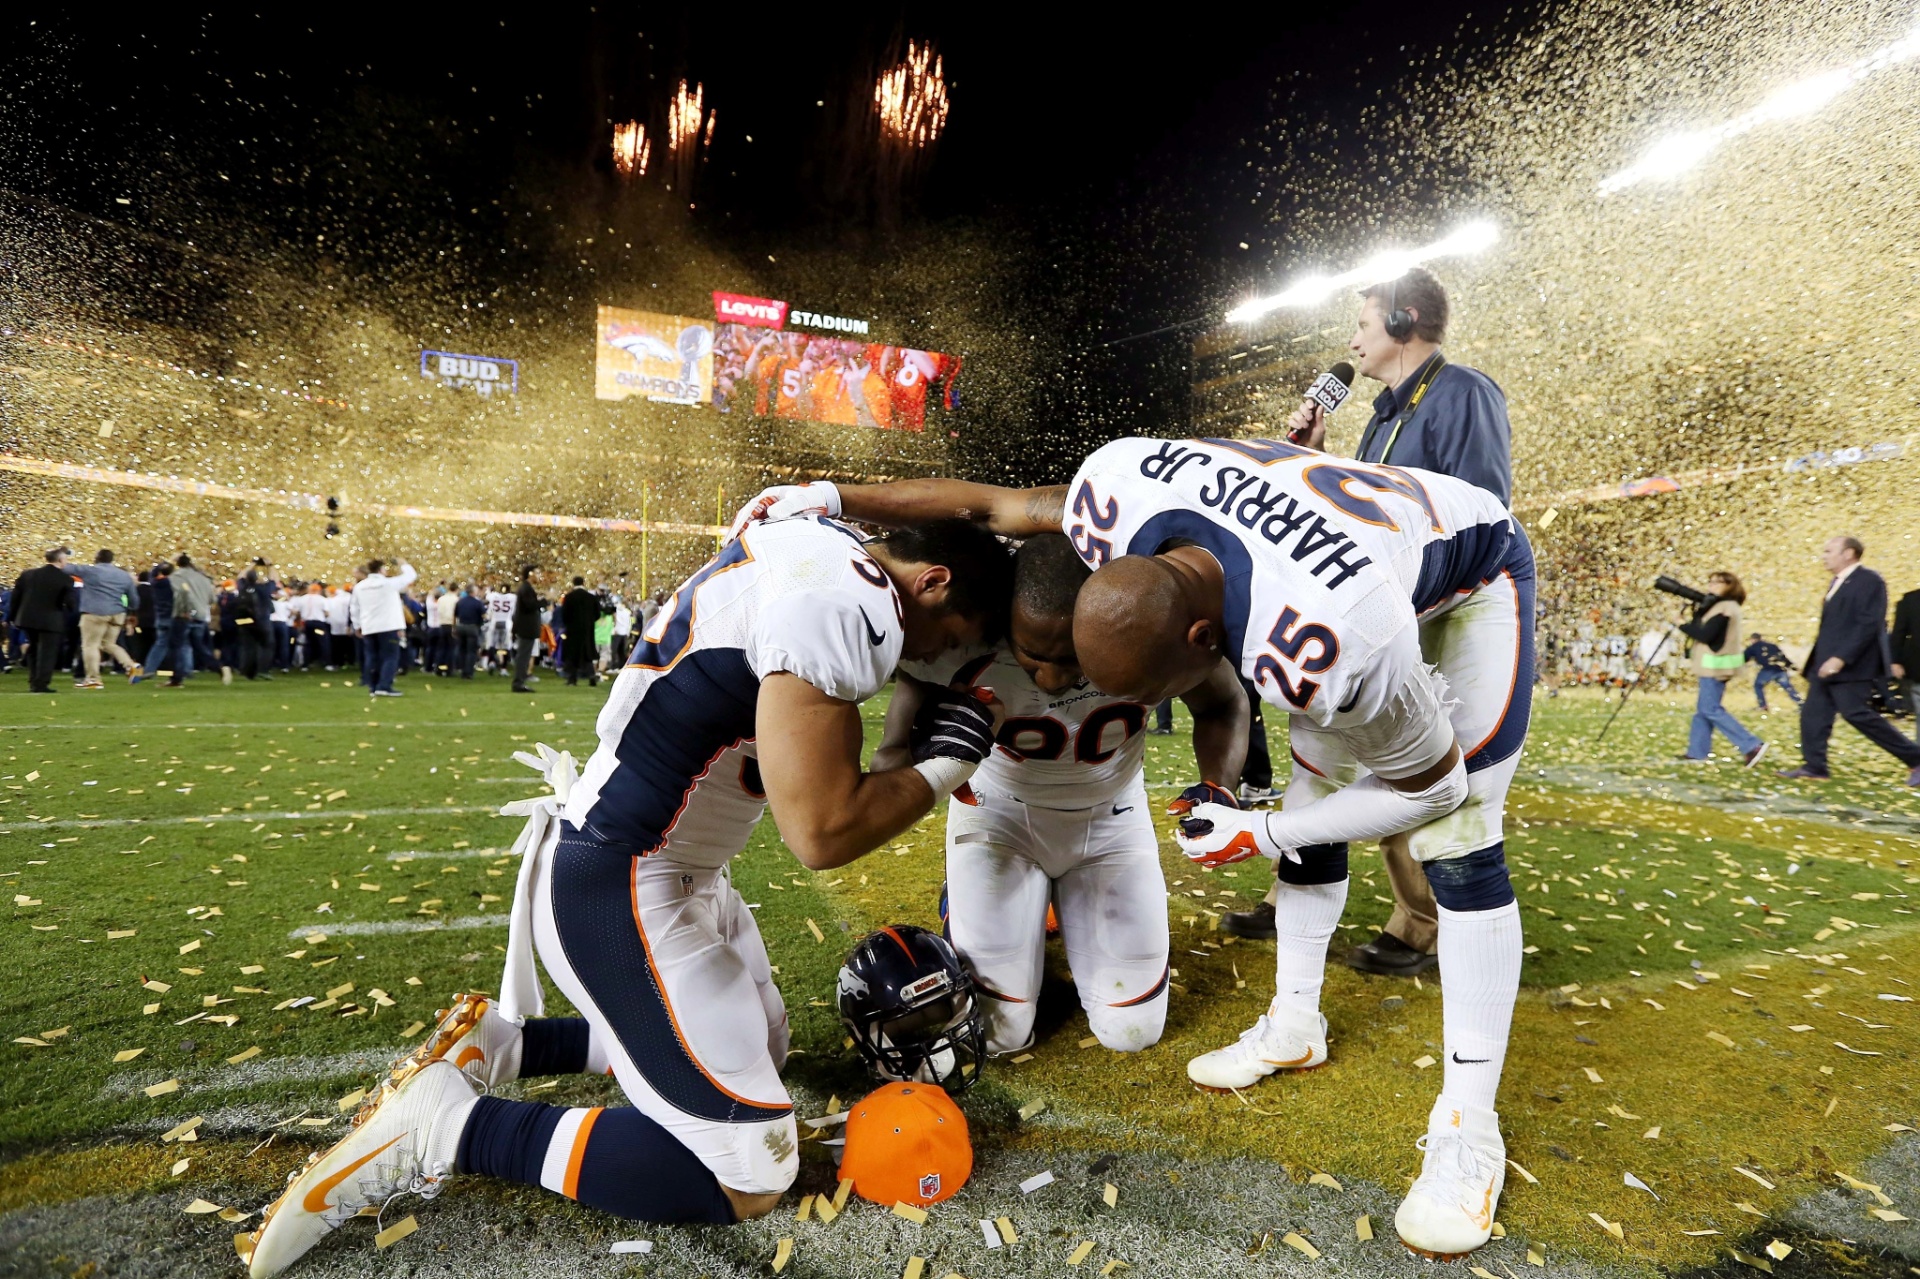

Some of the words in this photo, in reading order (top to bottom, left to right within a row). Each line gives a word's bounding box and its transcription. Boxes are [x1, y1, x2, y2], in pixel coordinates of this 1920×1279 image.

[790, 310, 869, 334] STADIUM
[439, 356, 500, 381] BUD
[616, 372, 700, 398] CHAMPIONS
[1325, 379, 1346, 400] 850
[1317, 391, 1336, 408] KOA
[1140, 442, 1211, 484] JR
[1070, 479, 1119, 567] 25
[1200, 467, 1372, 590] HARRIS
[493, 600, 510, 612] 55
[1253, 605, 1340, 711] 25
[1048, 691, 1107, 709] BRONCOS
